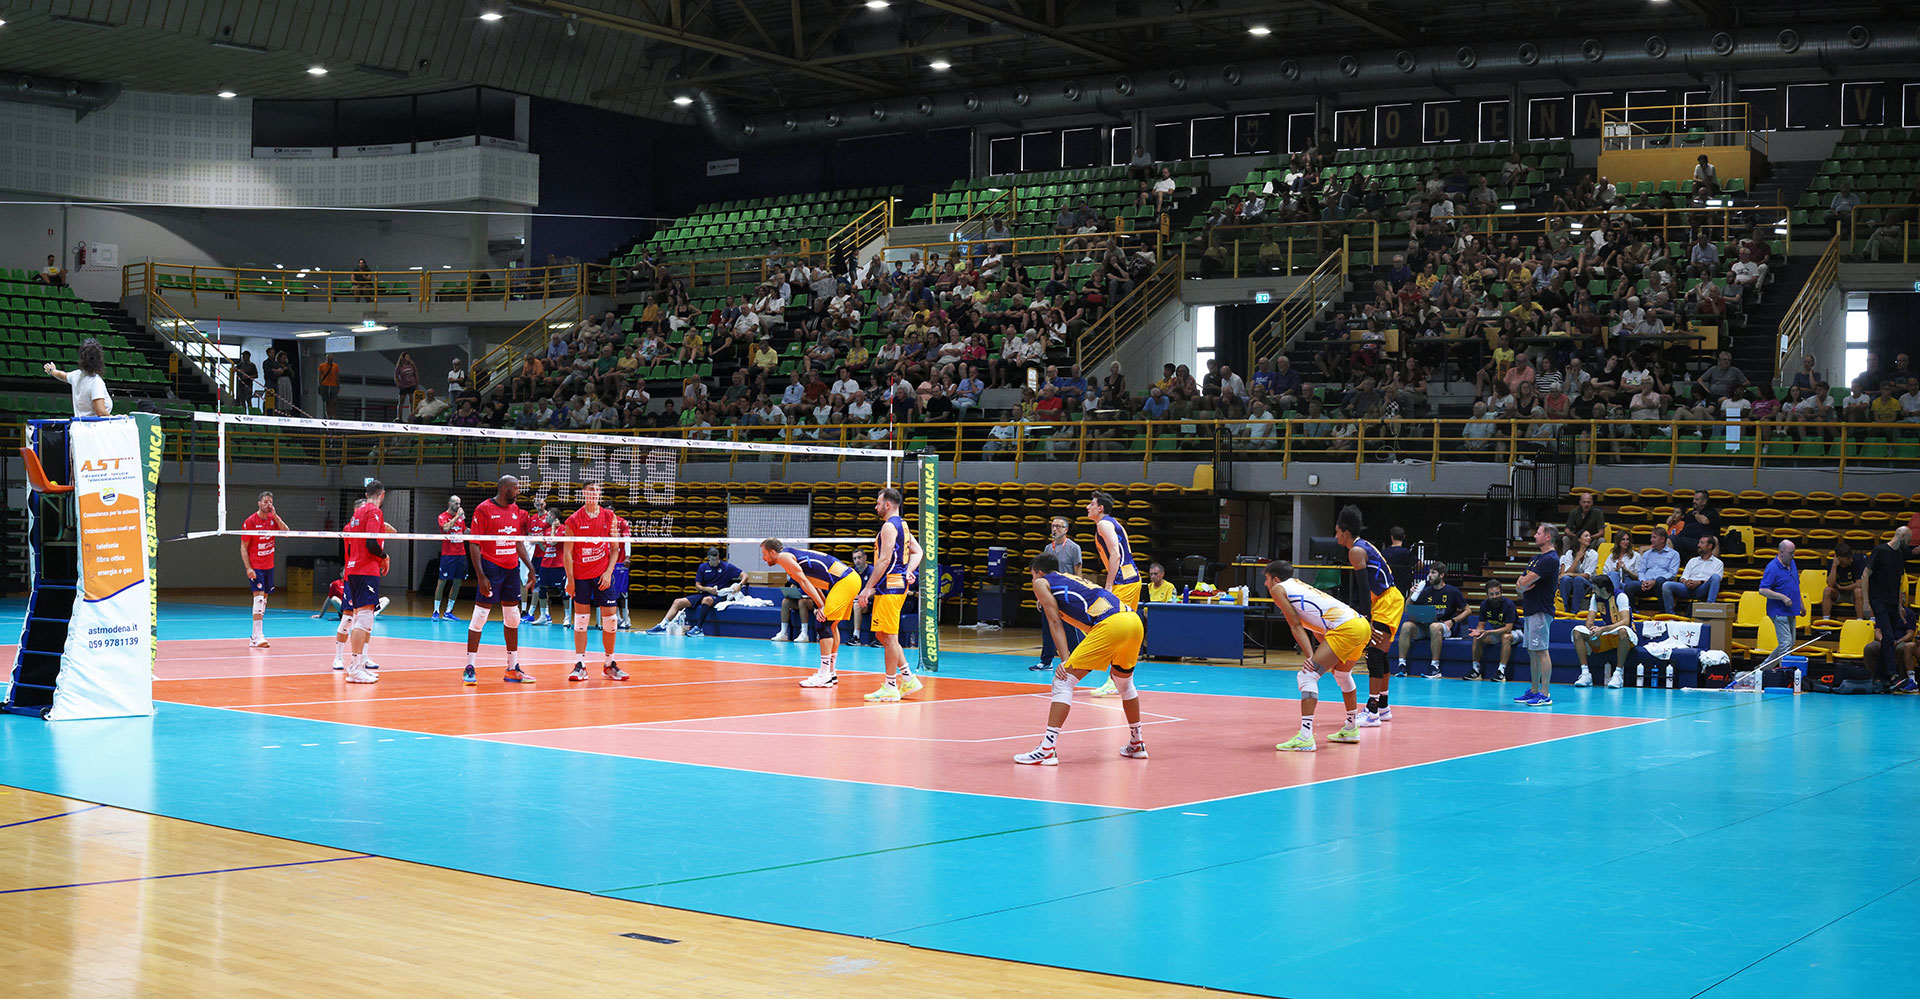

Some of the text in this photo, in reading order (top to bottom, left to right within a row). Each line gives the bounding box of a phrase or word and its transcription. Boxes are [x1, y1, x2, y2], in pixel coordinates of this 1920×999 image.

[81, 457, 122, 472] AST
[147, 424, 162, 558] CREDEM BANCA
[109, 510, 117, 518] per
[924, 463, 936, 561] CREDEM BANCA
[96, 542, 119, 550] telefonia
[96, 554, 125, 563] fibra ottica
[97, 568, 118, 577] energia
[122, 567, 133, 576] gas
[925, 568, 937, 663] CREDEM BANCA
[88, 623, 139, 637] astmodena.it
[88, 636, 139, 649] 059 9781139
